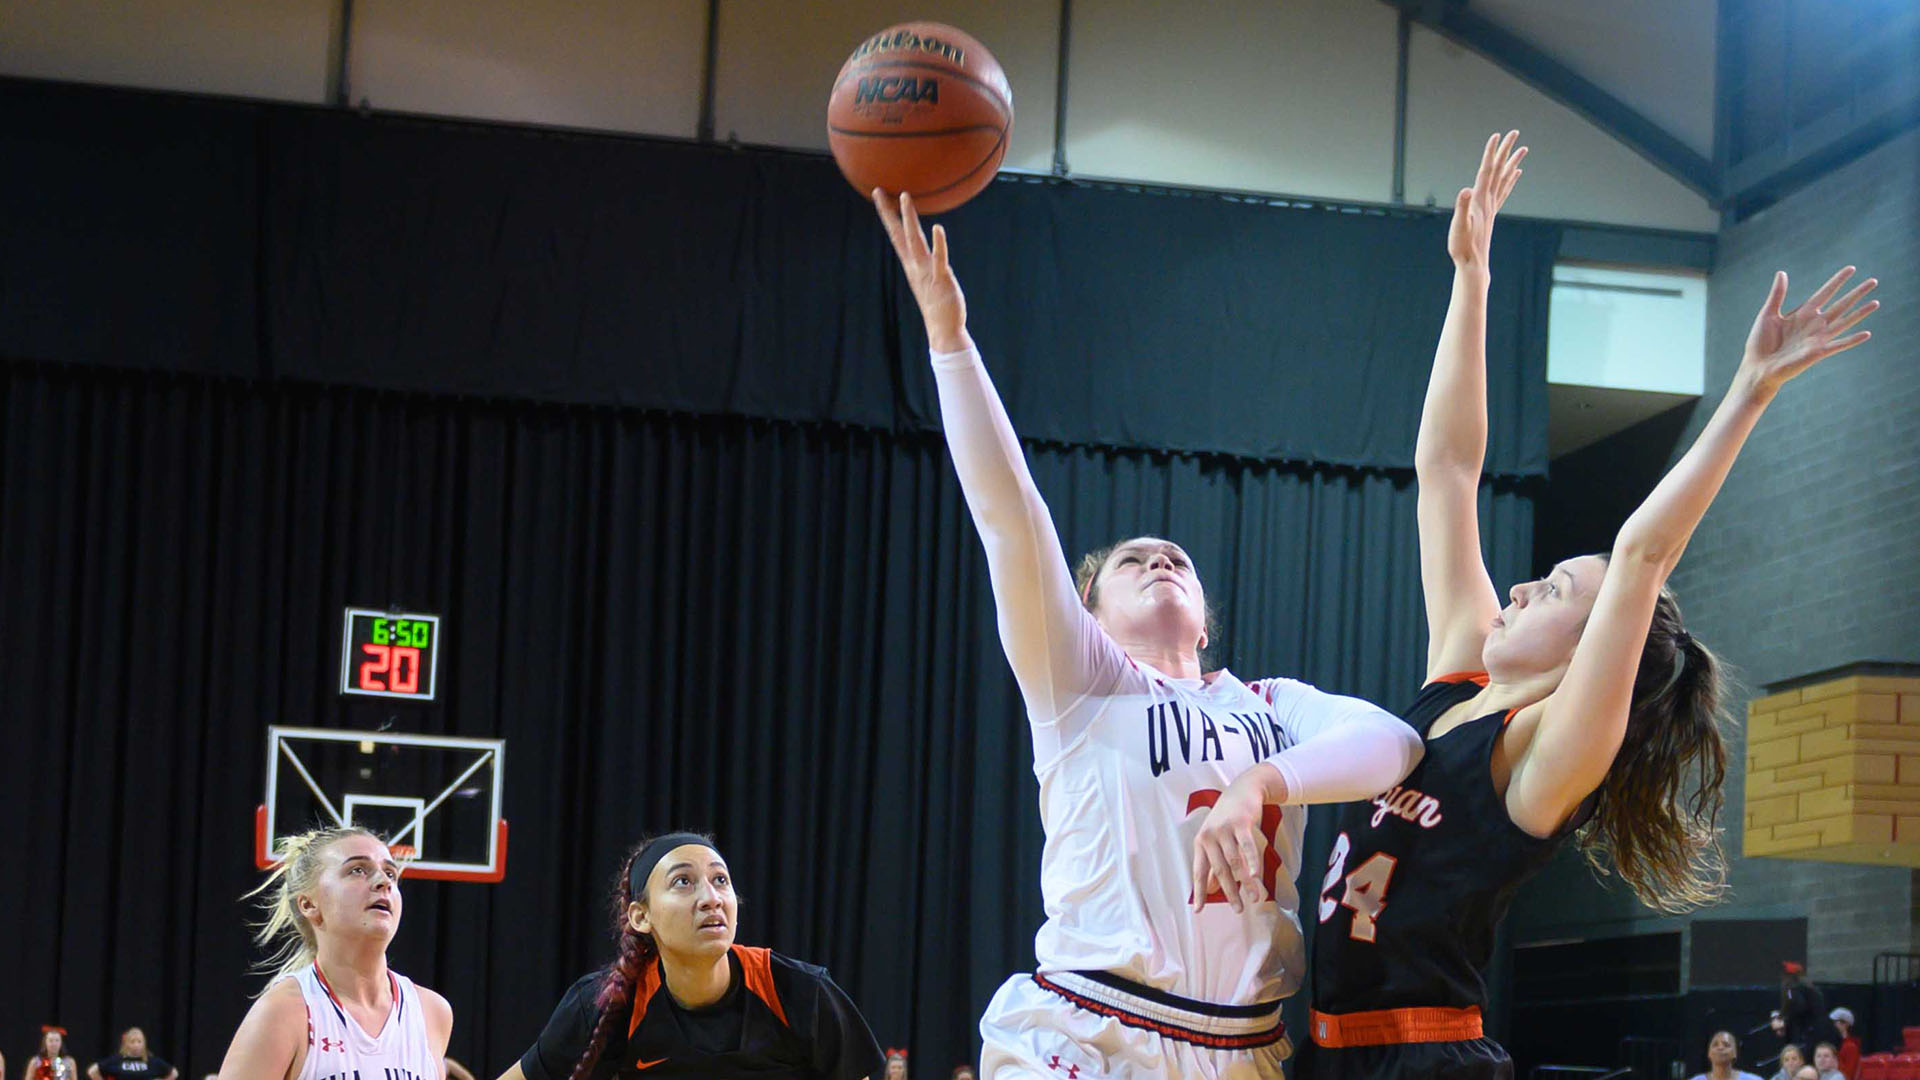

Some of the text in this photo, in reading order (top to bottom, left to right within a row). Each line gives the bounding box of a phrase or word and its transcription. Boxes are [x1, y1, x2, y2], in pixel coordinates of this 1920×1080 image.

[854, 76, 939, 105] NCAA
[373, 618, 430, 649] 6:50
[360, 643, 420, 694] 20
[1318, 831, 1398, 943] 24
